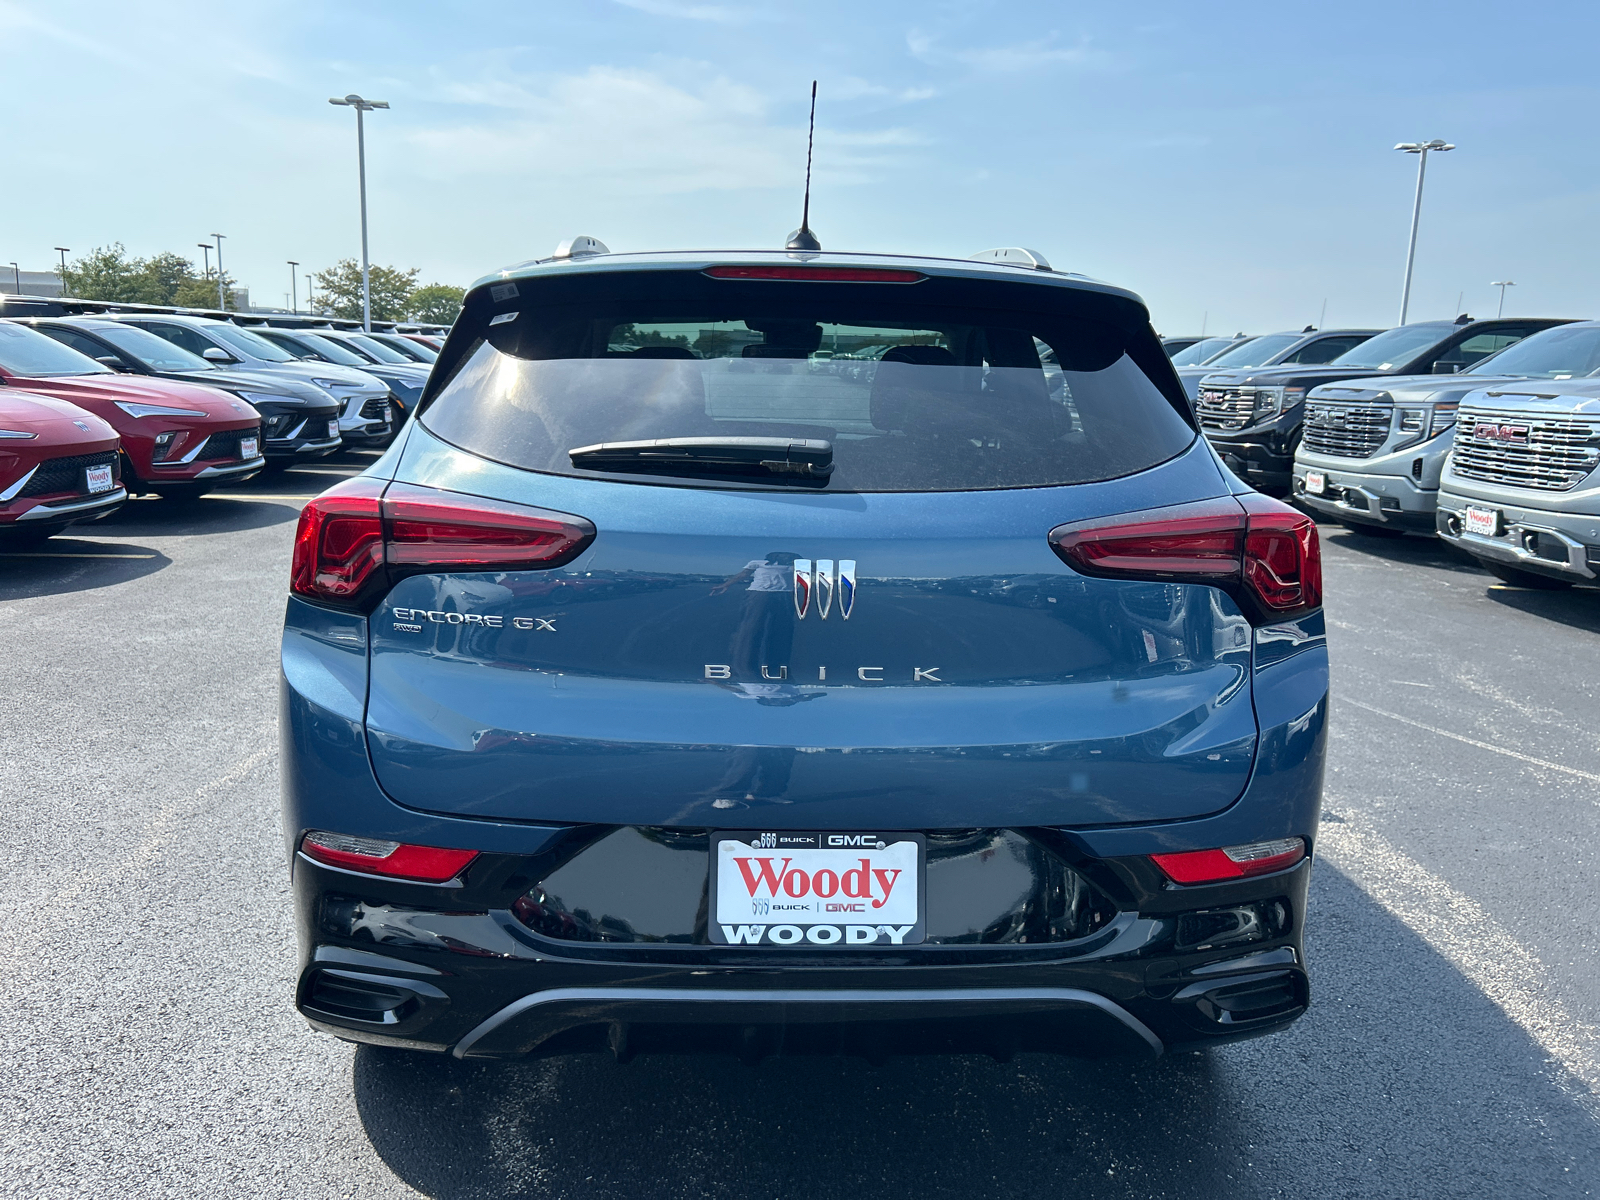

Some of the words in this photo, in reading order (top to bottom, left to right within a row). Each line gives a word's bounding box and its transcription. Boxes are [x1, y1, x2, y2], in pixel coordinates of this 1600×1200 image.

[1475, 424, 1527, 443] GMC
[88, 471, 109, 482] Woody
[90, 484, 113, 493] WOODY
[1469, 510, 1493, 527] Woody
[393, 607, 503, 628] ENCORE
[513, 617, 557, 632] GX
[393, 622, 422, 633] AWD
[704, 664, 942, 682] BUICK
[779, 836, 815, 844] BUICK
[827, 834, 877, 846] GMC
[733, 857, 902, 909] Woody
[825, 903, 866, 913] GMC
[721, 924, 914, 945] WOODY
